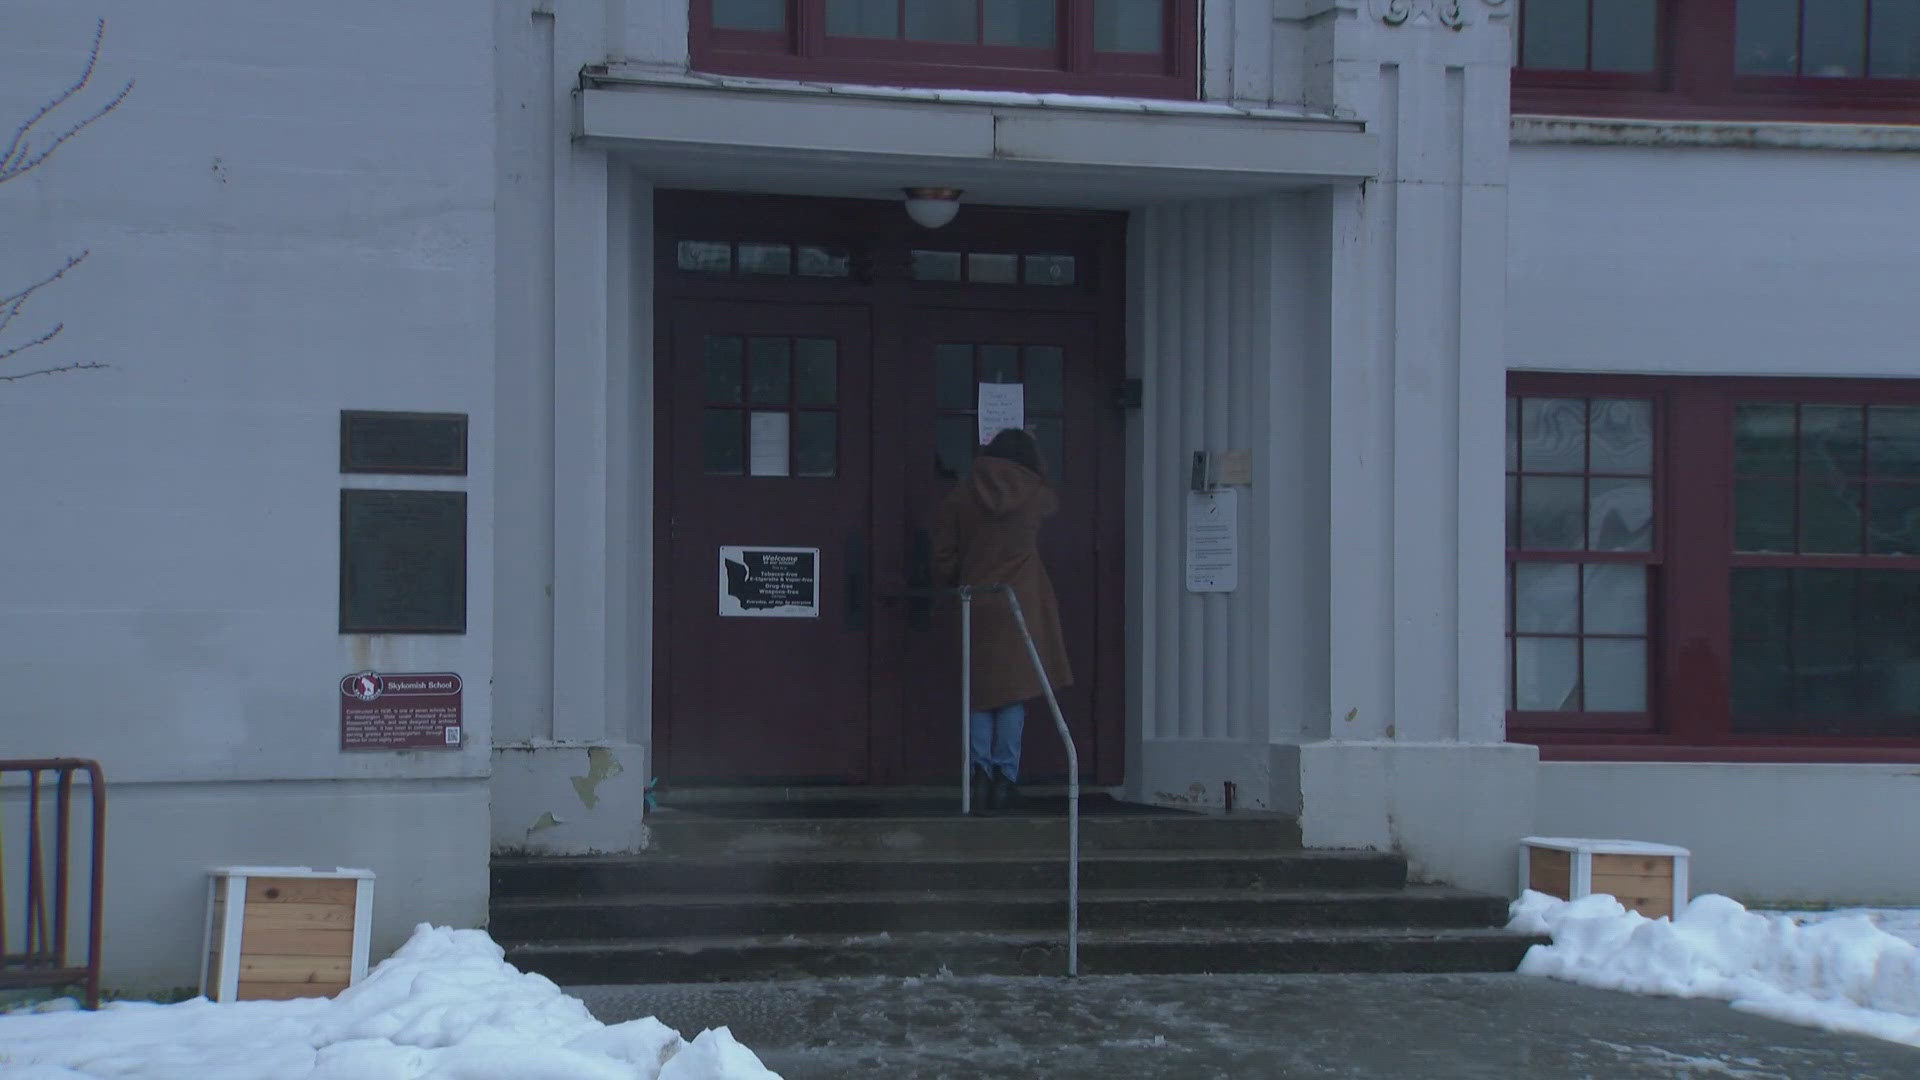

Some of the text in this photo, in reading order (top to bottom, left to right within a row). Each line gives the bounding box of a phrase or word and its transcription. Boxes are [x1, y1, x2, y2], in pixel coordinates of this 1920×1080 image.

[762, 554, 798, 562] Welcome
[387, 680, 452, 691] Skykomish School
